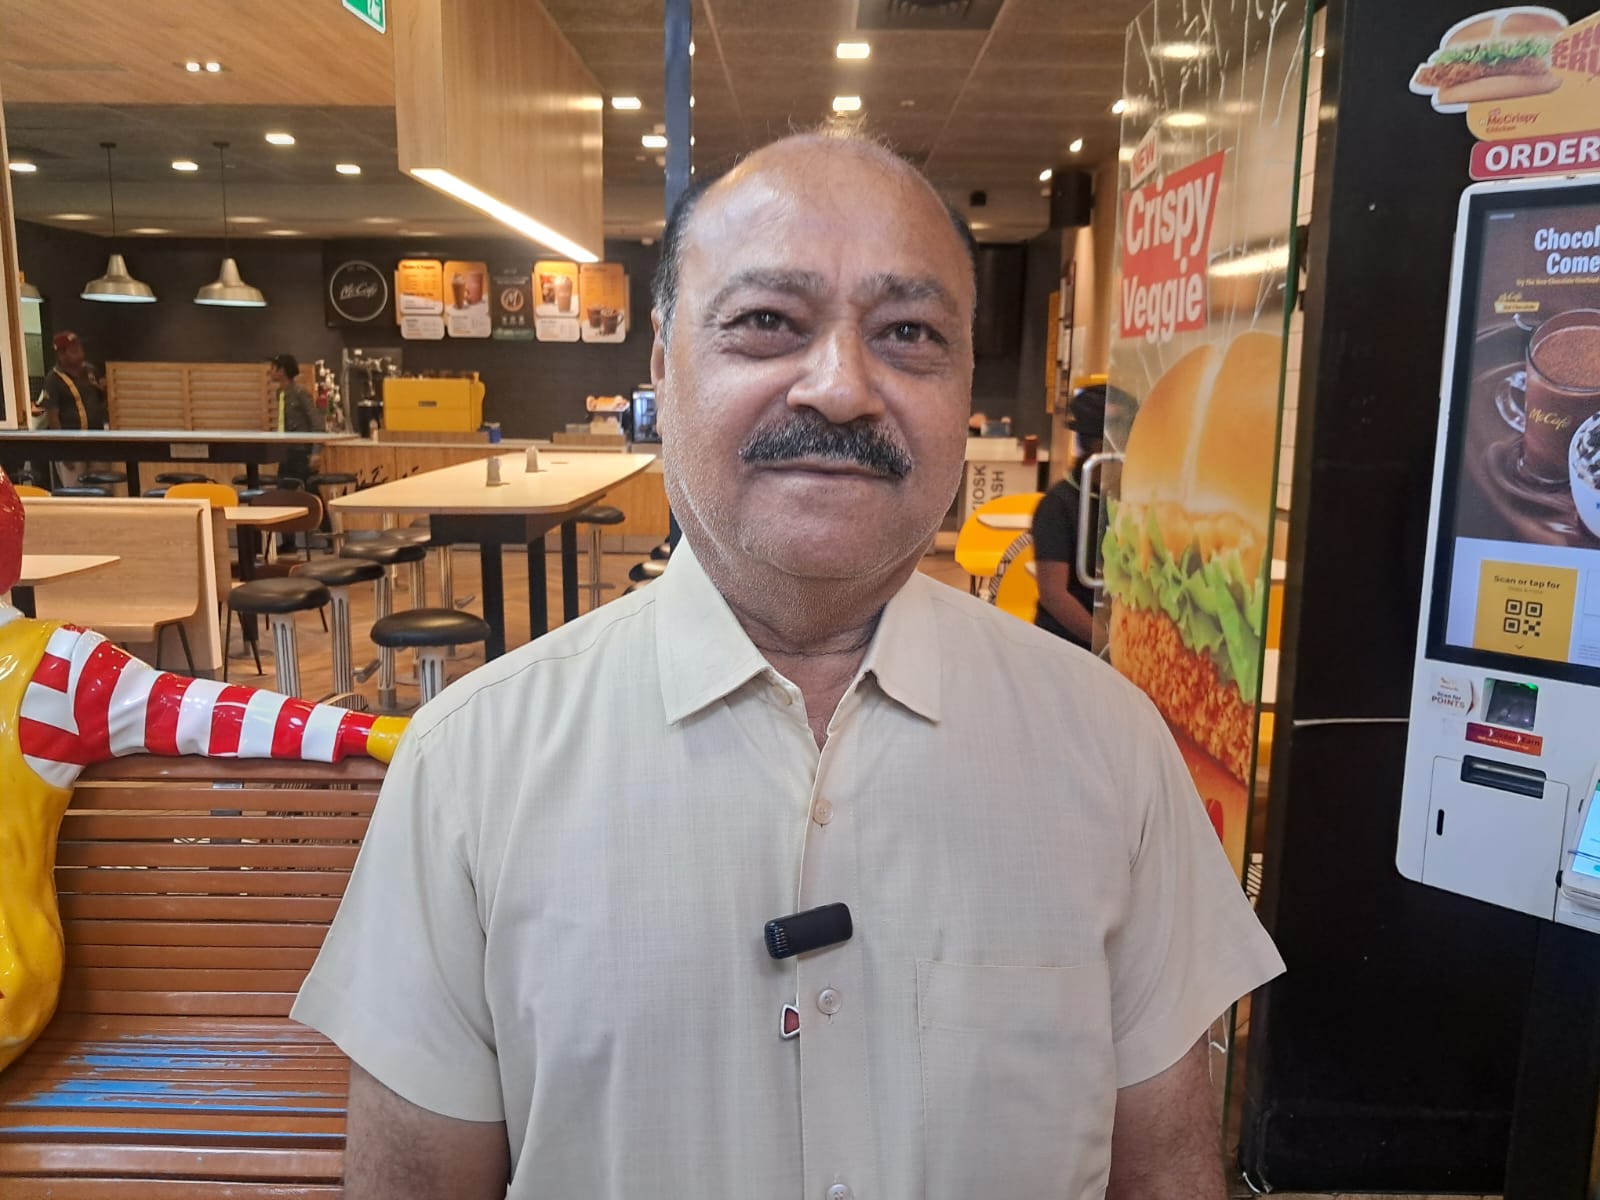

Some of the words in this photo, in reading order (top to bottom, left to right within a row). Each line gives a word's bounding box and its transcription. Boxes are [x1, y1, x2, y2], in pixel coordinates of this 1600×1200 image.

[1132, 138, 1155, 178] NEW
[1485, 135, 1600, 171] ORDER
[1126, 172, 1215, 260] Crispy
[1123, 256, 1203, 344] Veggie
[972, 464, 986, 511] IOSK
[1494, 575, 1516, 584] Scan
[1529, 579, 1545, 589] tap
[1547, 580, 1560, 589] for
[1431, 695, 1465, 709] POINTS
